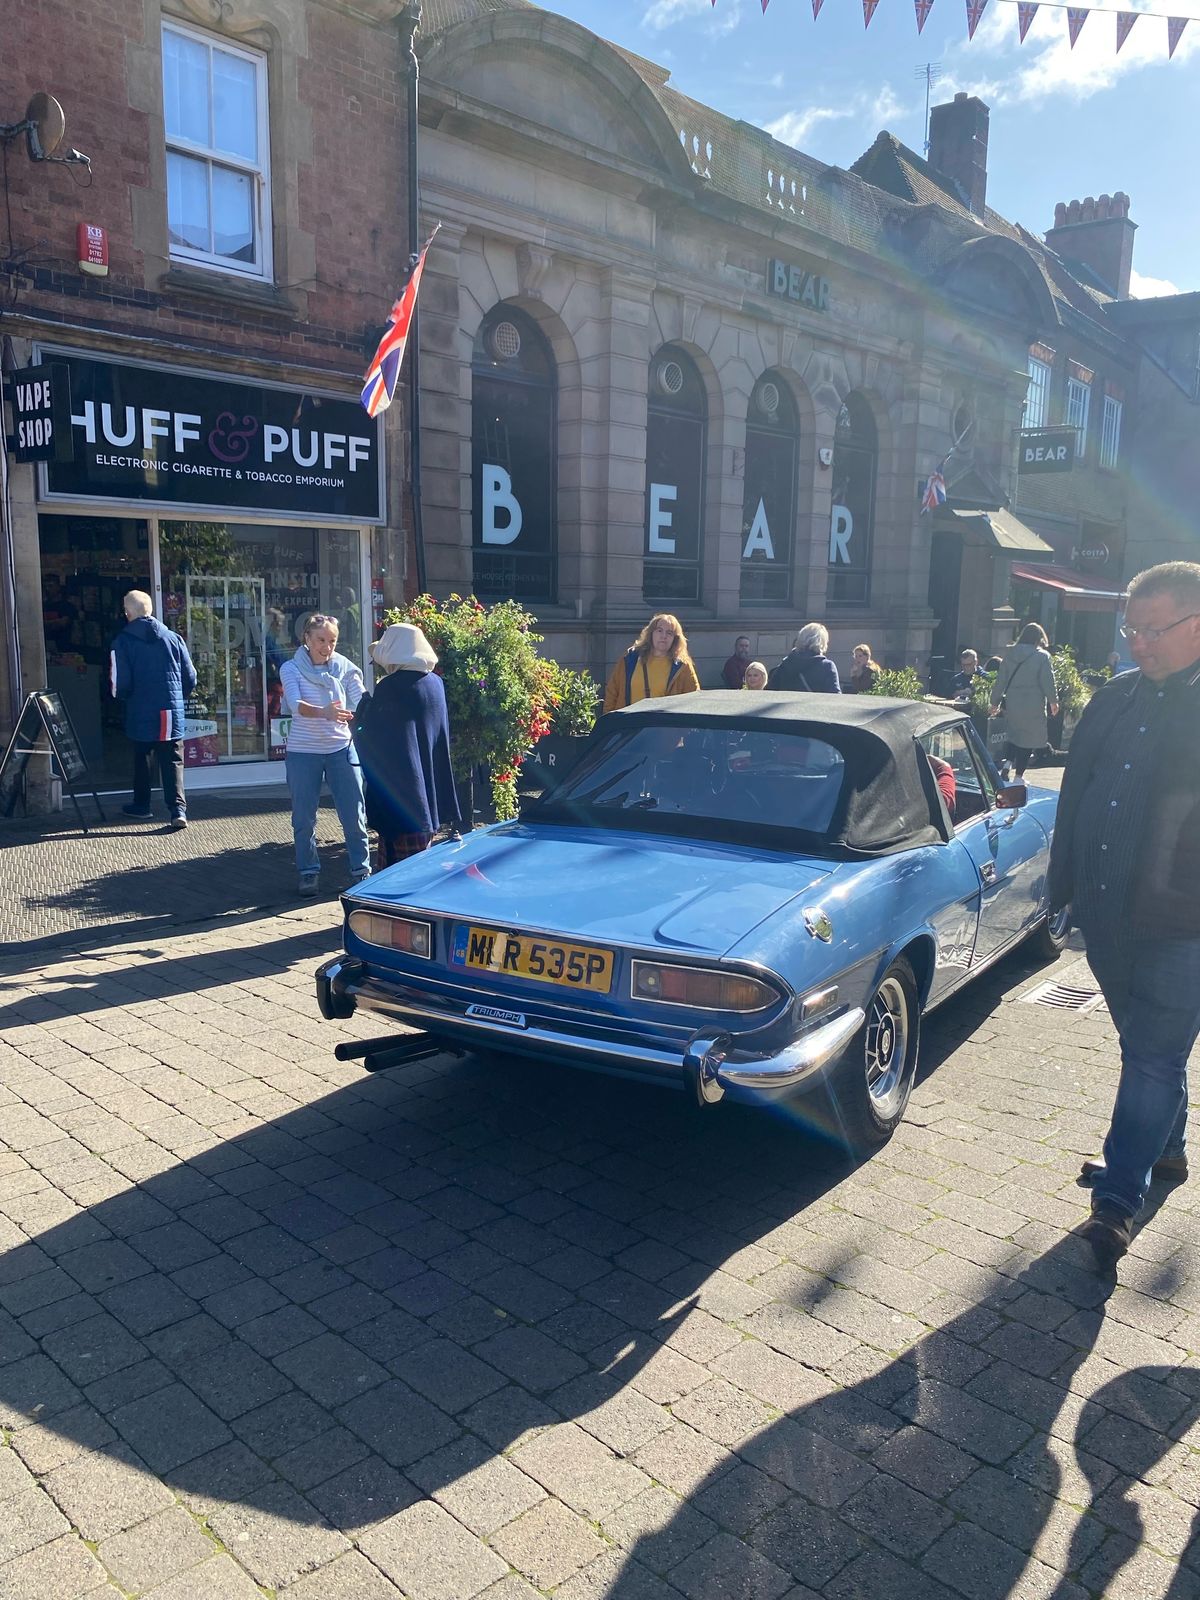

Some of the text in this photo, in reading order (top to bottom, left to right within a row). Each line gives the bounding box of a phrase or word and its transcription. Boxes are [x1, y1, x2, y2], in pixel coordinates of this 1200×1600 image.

[87, 226, 103, 237] KB
[774, 258, 832, 309] BEAR
[16, 380, 51, 412] VAPE
[18, 417, 52, 448] SHOP
[71, 400, 371, 472] HUFF & PUFF
[1025, 446, 1067, 462] BEAR
[96, 454, 345, 488] ELECTRONIC CIGARETTE & TOBACCO EMPORIUM
[285, 596, 318, 606] EXPERT
[528, 943, 606, 985] 535P
[473, 1005, 521, 1022] TRIUMPH
